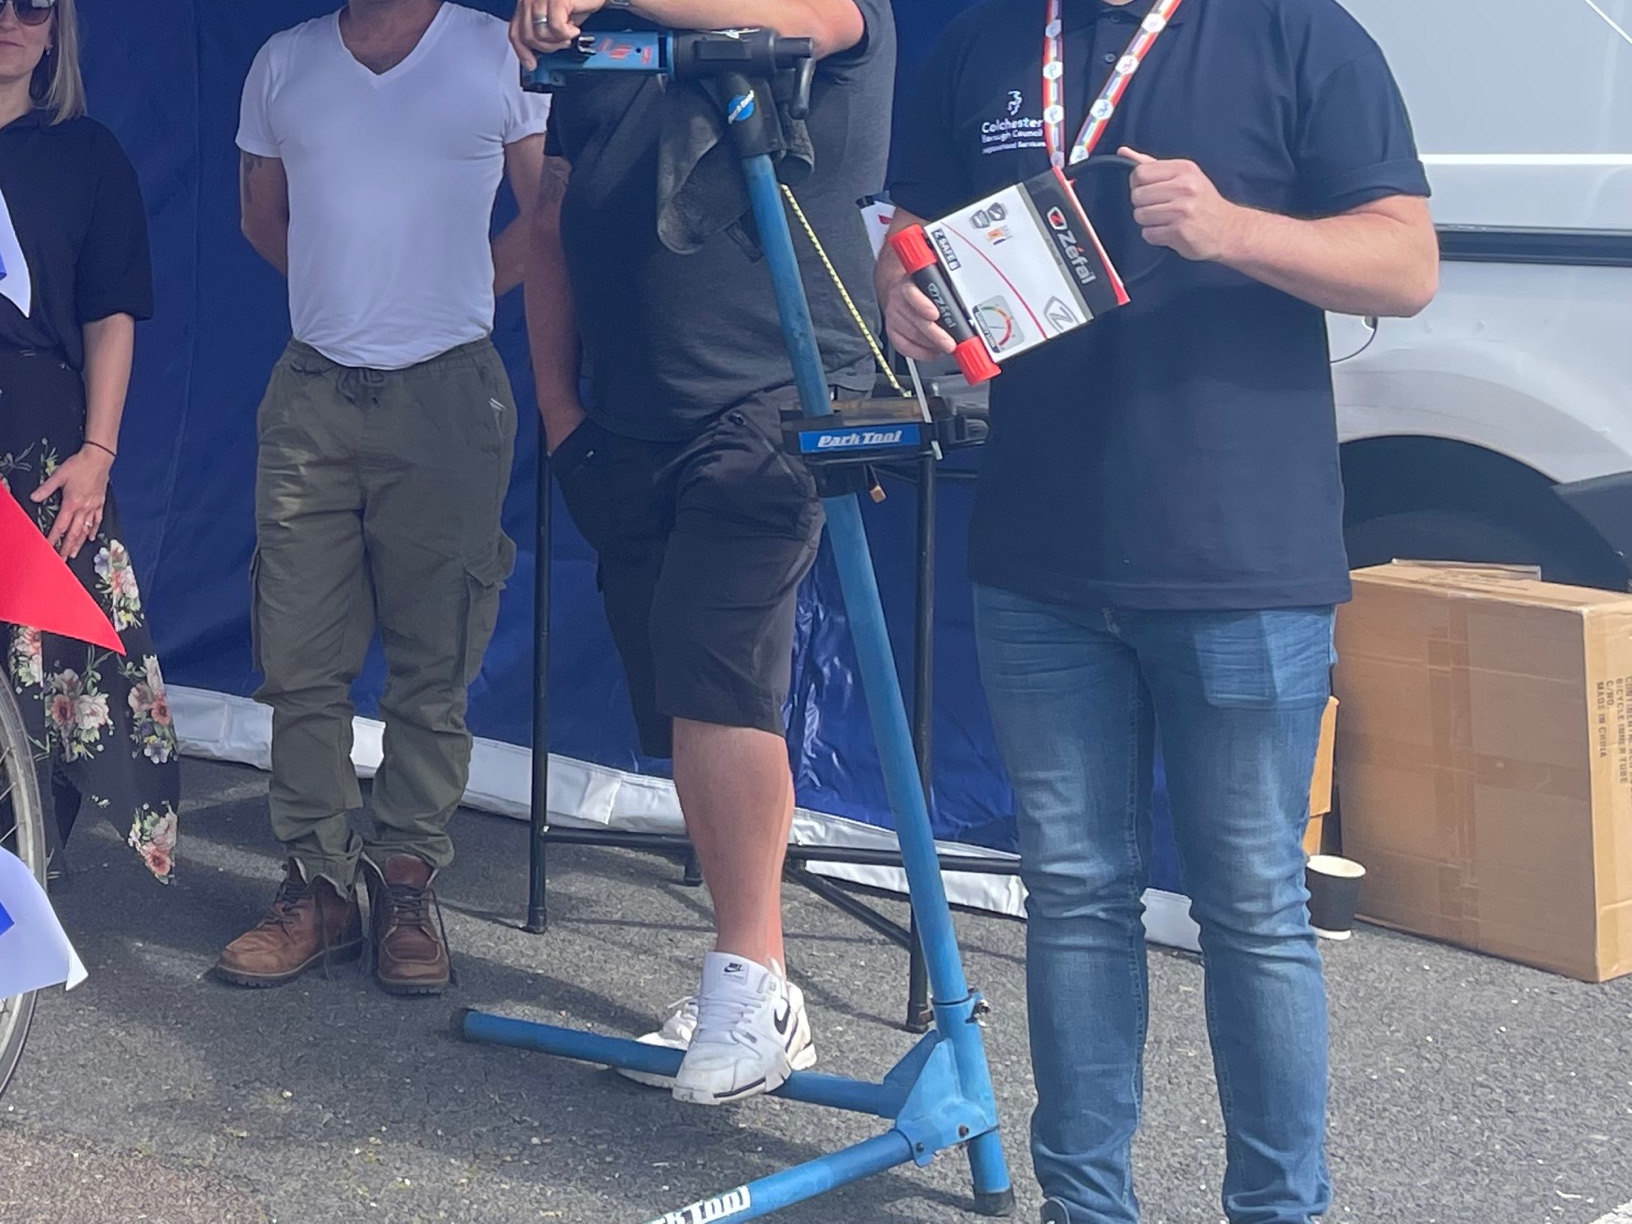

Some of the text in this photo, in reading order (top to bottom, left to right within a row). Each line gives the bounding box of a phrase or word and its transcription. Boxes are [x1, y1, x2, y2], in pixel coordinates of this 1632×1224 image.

[981, 117, 1044, 133] Colchester
[818, 430, 903, 447] Park Tool
[1616, 677, 1625, 721] BICYCLE
[1619, 757, 1628, 784] TUBE
